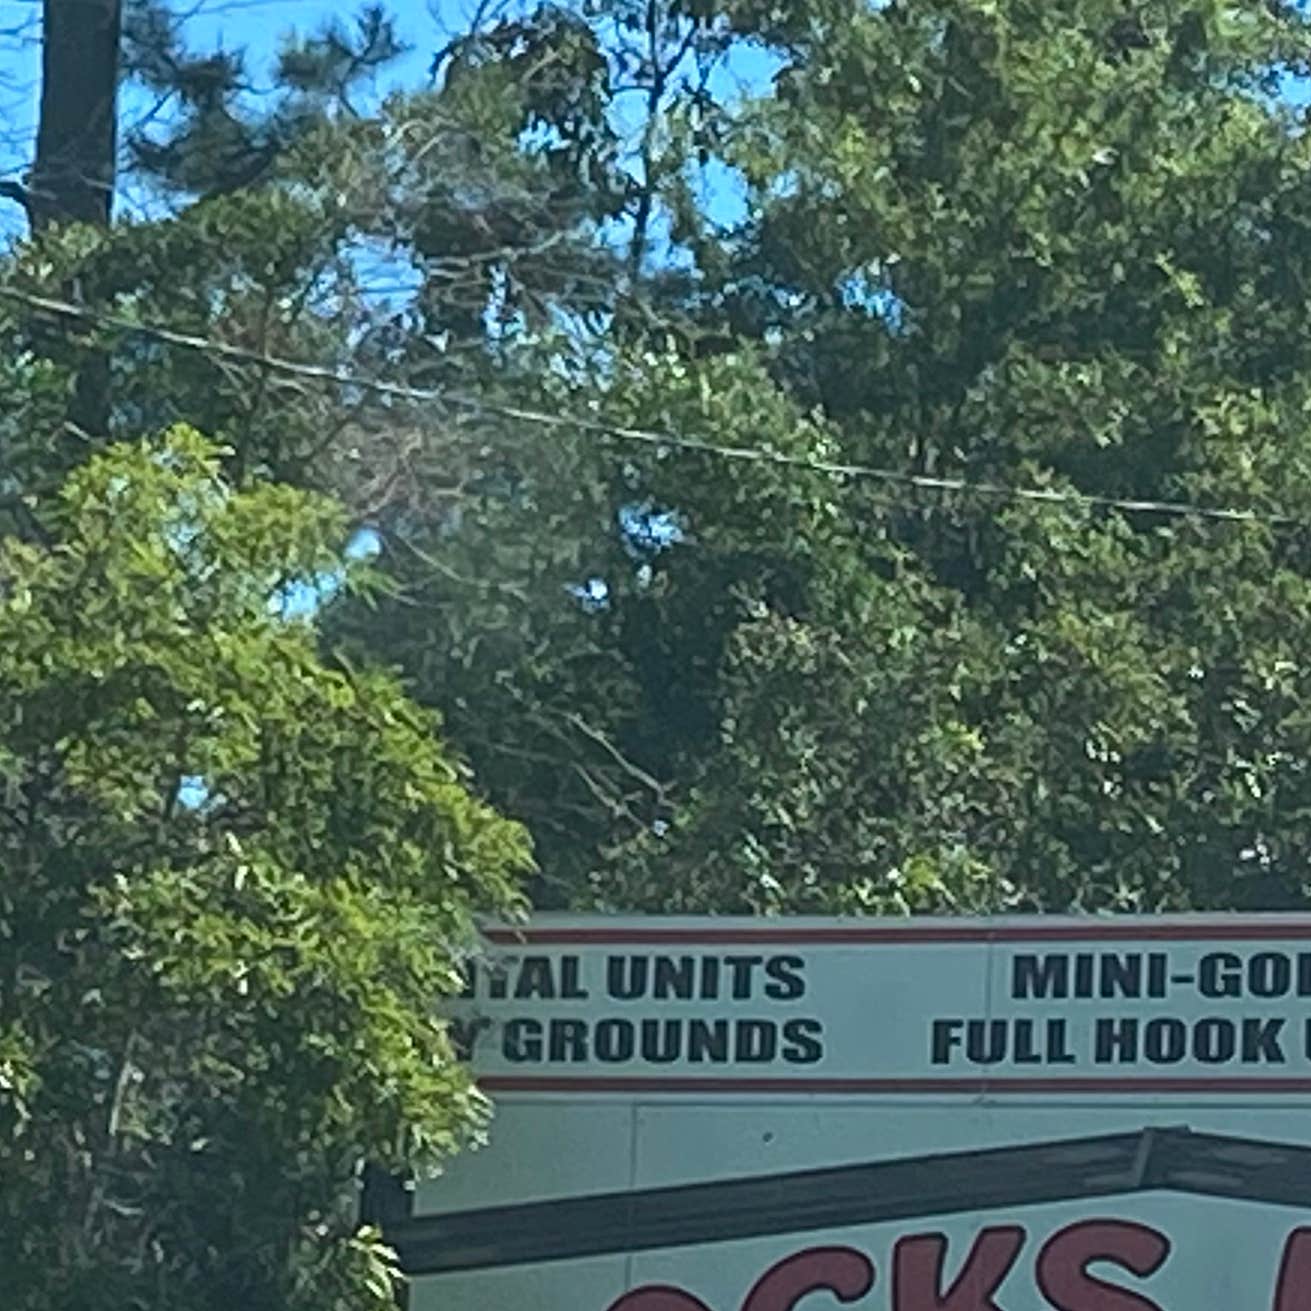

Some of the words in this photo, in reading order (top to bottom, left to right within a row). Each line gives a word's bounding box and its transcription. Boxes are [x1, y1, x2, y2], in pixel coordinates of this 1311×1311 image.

[606, 954, 806, 1000] UNITS
[502, 1017, 824, 1064] GROUNDS
[930, 1018, 1076, 1065] FULL
[1094, 1017, 1287, 1064] HOOK
